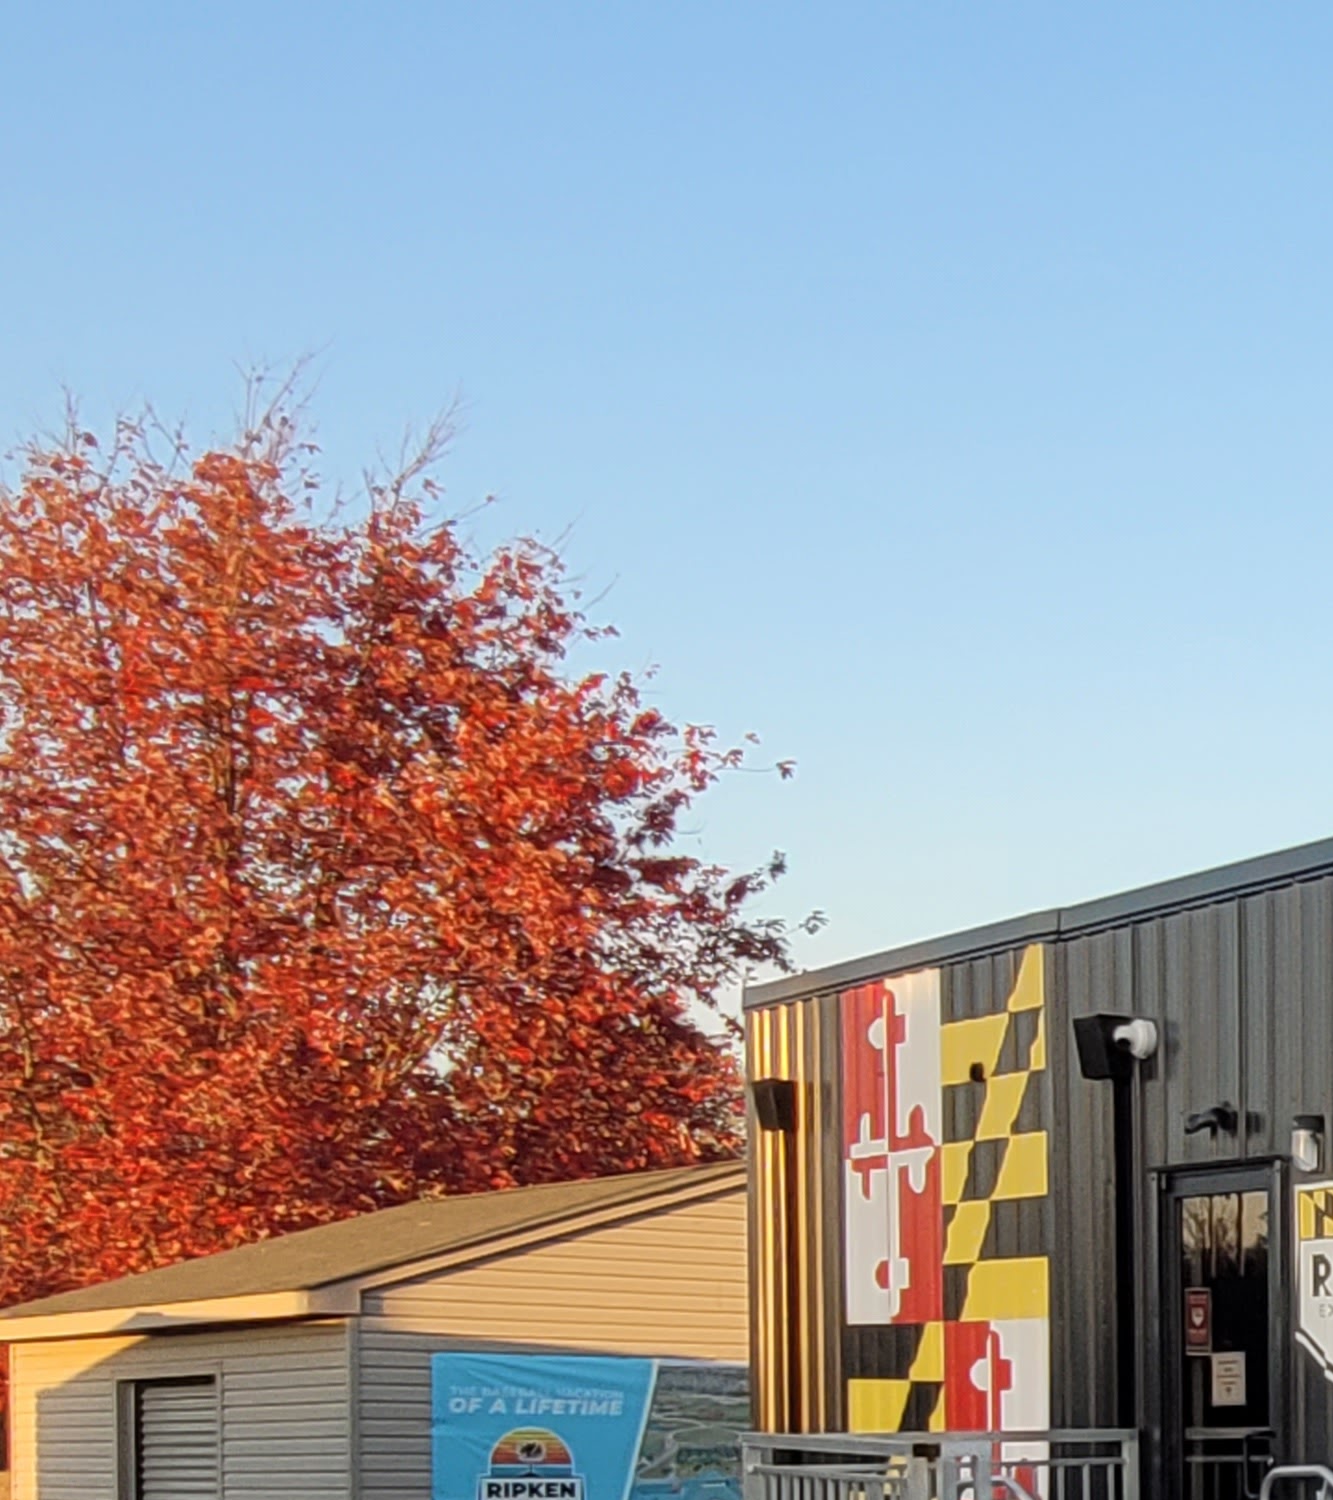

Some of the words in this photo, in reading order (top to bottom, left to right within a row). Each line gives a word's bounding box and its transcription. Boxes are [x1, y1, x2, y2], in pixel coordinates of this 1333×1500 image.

[449, 1397, 483, 1415] OF
[487, 1397, 508, 1415] A
[515, 1397, 624, 1417] LIFETIME
[486, 1482, 576, 1499] RIPKEN
